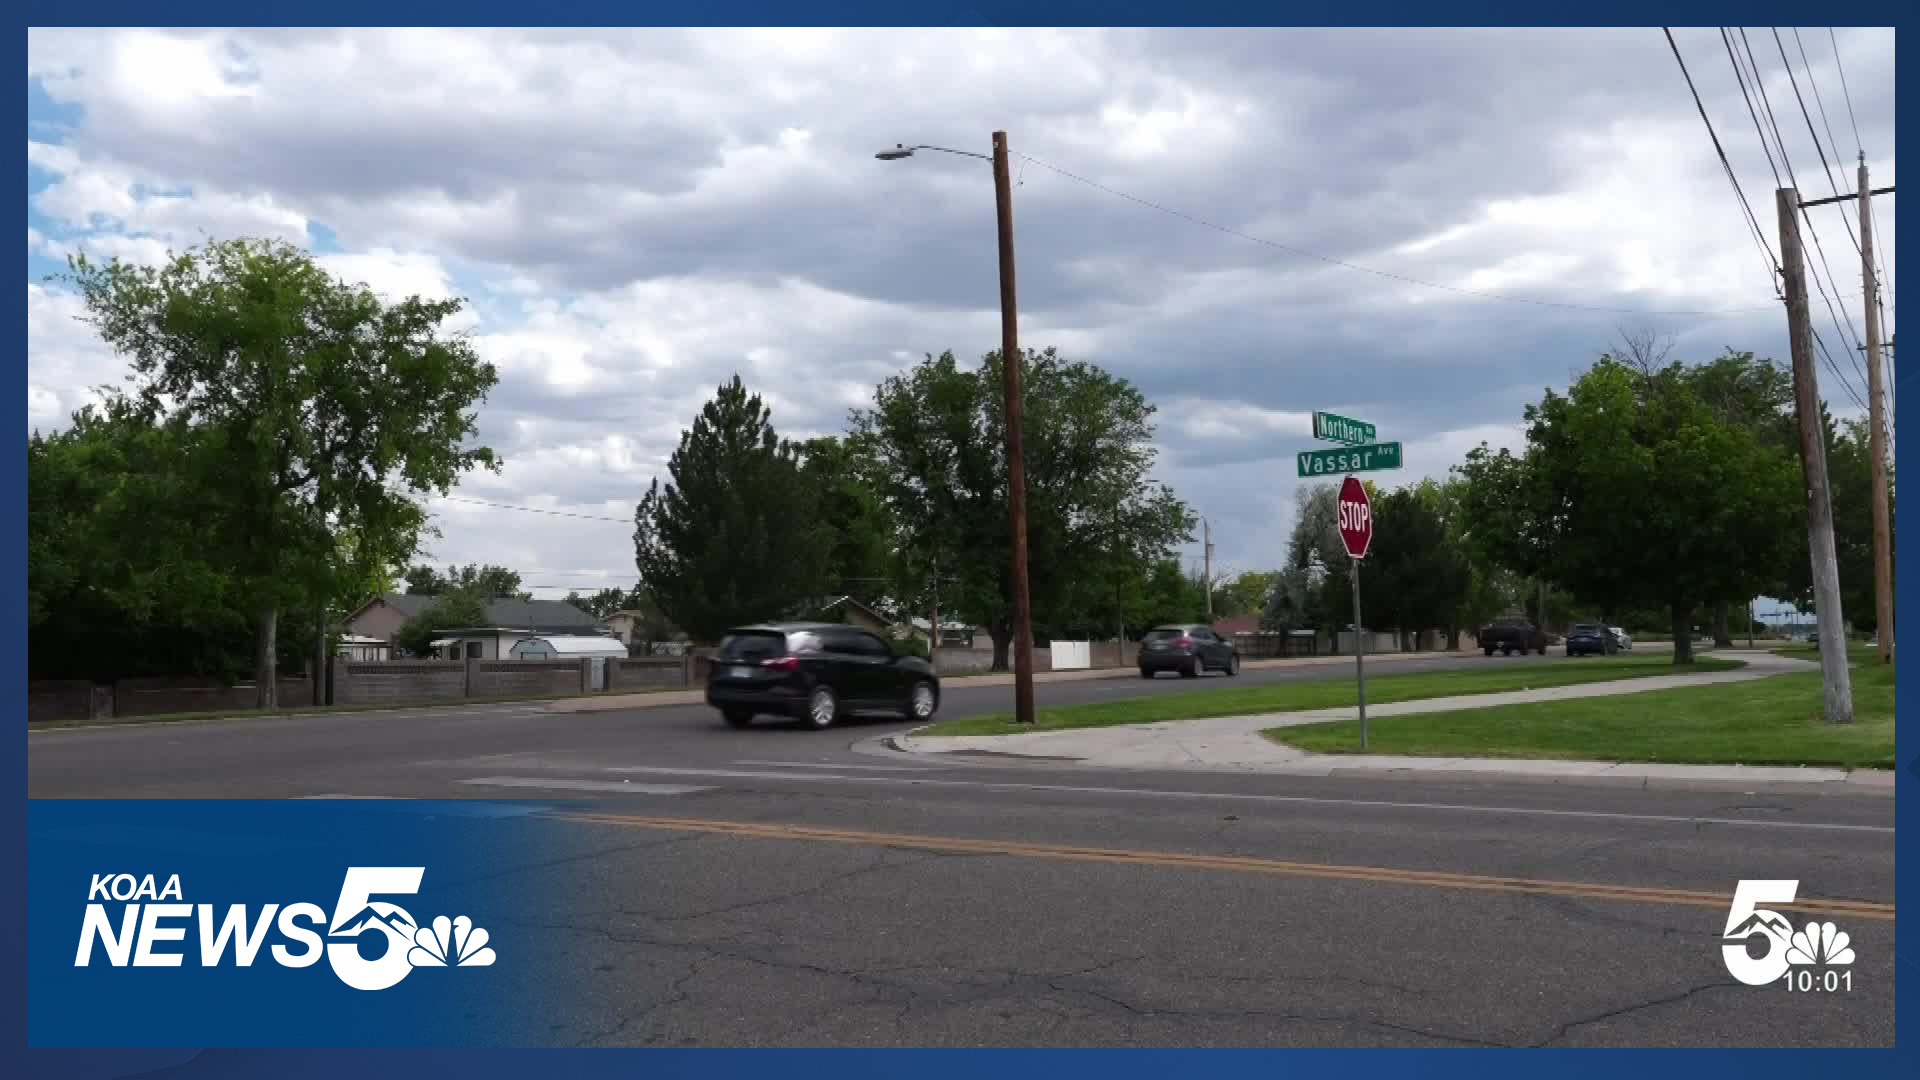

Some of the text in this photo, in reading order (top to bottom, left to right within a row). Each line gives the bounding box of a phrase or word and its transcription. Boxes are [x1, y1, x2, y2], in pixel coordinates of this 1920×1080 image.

[1320, 415, 1363, 444] Northern
[1301, 453, 1372, 473] Vassar
[1340, 500, 1369, 532] STOP
